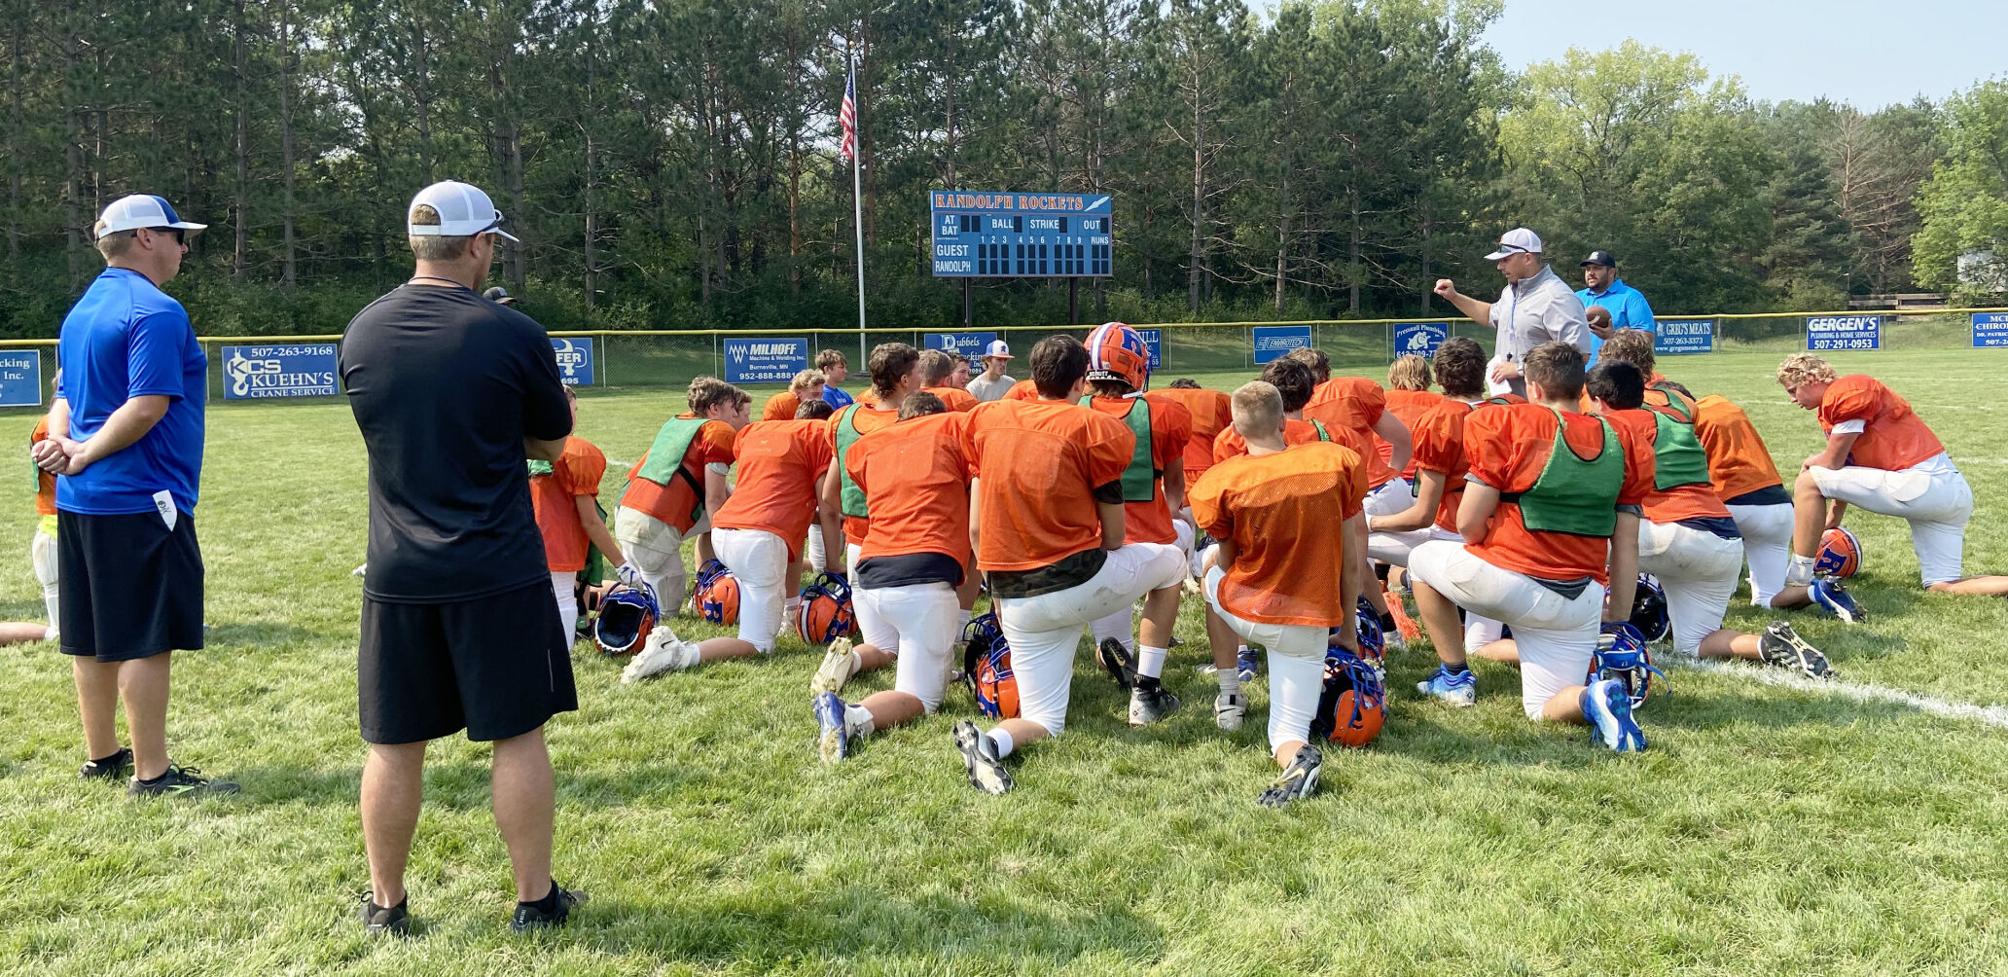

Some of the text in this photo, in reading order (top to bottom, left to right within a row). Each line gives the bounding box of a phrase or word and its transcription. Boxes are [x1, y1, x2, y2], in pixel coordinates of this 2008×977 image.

[935, 194, 1084, 210] RANDOLPH ROCKETS
[944, 214, 956, 225] AT
[991, 219, 1100, 230] BALL STRIKE OUT
[941, 225, 958, 236] BAT
[991, 235, 996, 243] 2
[1002, 235, 1007, 244] 3
[1018, 236, 1023, 244] 4
[1029, 236, 1034, 244] 5
[1040, 236, 1045, 244] 6
[1056, 236, 1060, 244] 7
[1077, 236, 1081, 244] 9
[1091, 236, 1109, 244] RUNS
[936, 245, 969, 256] GUEST
[935, 260, 971, 272] RANDOLPH
[1666, 322, 1711, 335] GREG'S MEATS
[1808, 317, 1877, 331] GERGEN'S
[941, 334, 980, 350] Dubbels
[1814, 339, 1872, 349] 507-291-0953
[251, 346, 333, 357] 507-263-9168
[749, 344, 797, 355] MILHOFF
[4, 371, 24, 380] Inc.
[251, 371, 334, 388] KUEHN'S
[251, 387, 336, 398] CRANE SERVICE
